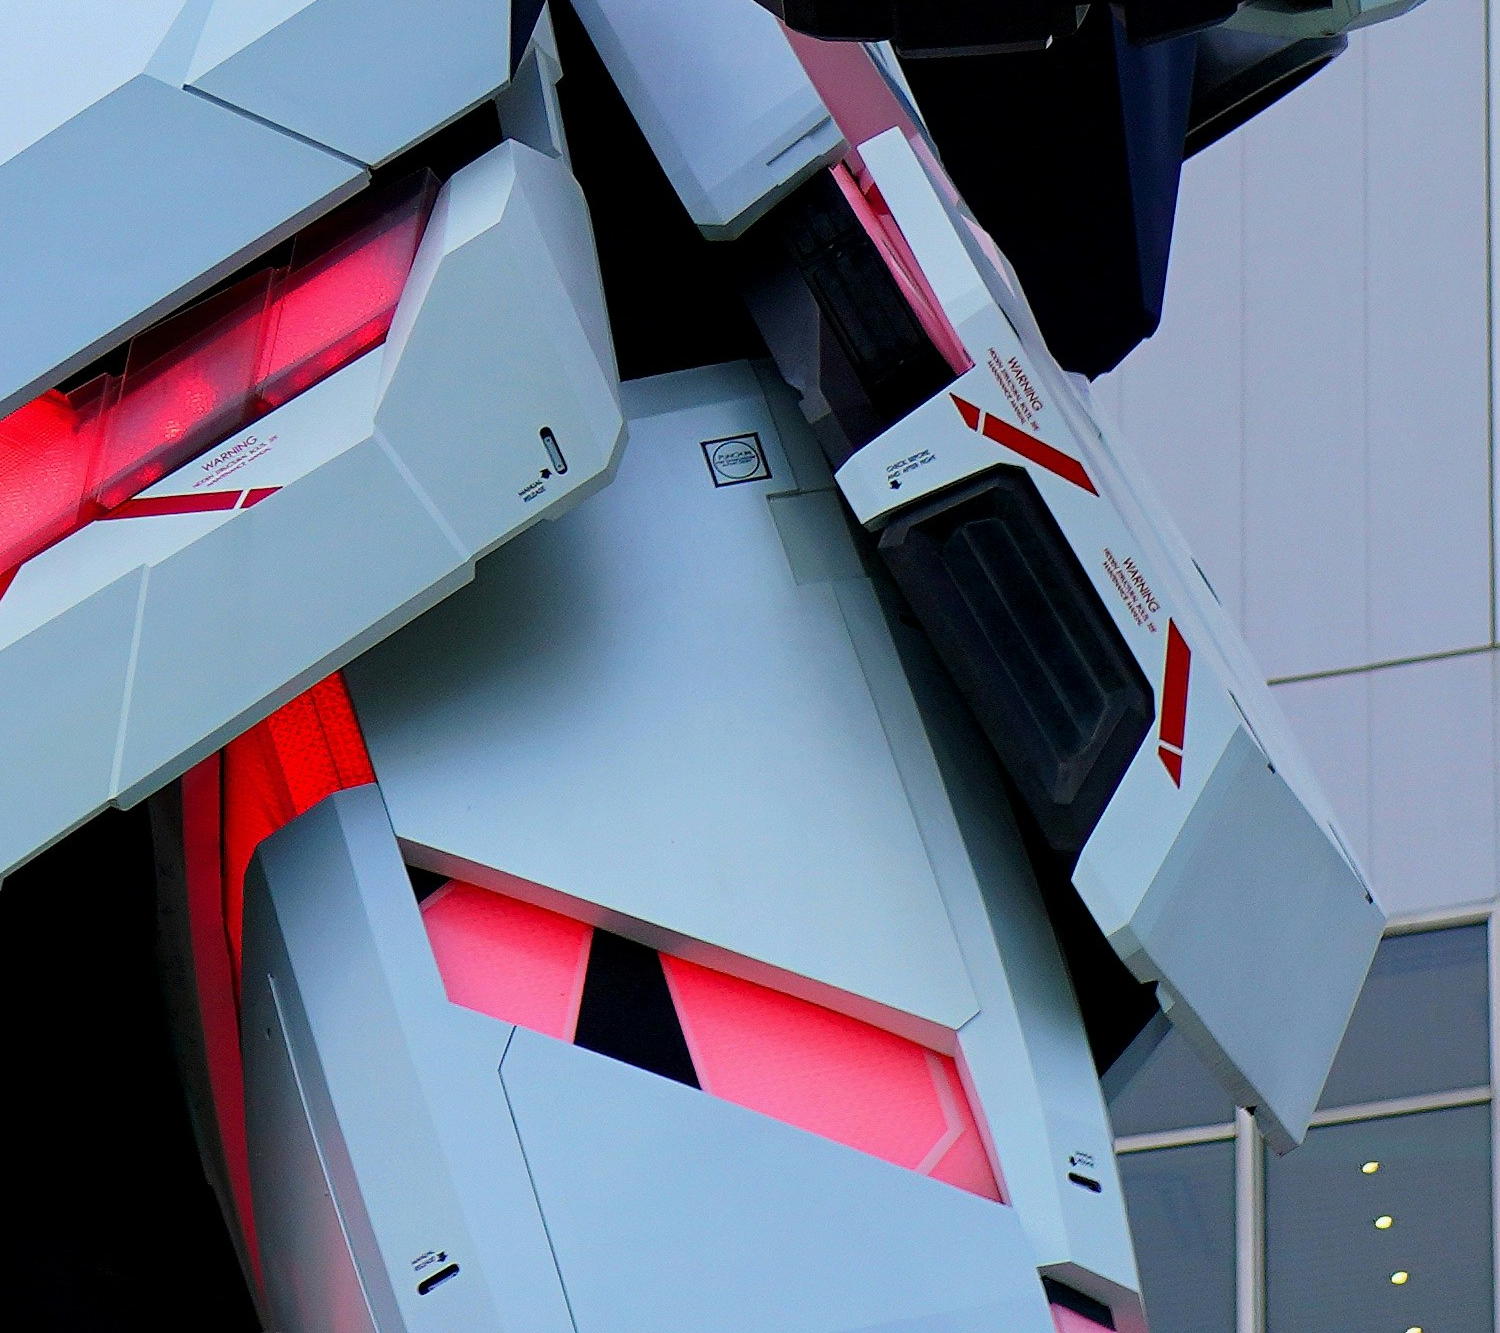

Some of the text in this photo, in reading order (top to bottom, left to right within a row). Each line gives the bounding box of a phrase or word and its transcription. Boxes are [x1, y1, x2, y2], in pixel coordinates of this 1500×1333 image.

[1007, 355, 1043, 412] WARNING
[202, 435, 258, 472] WARNING
[1122, 556, 1160, 613] WARNING
